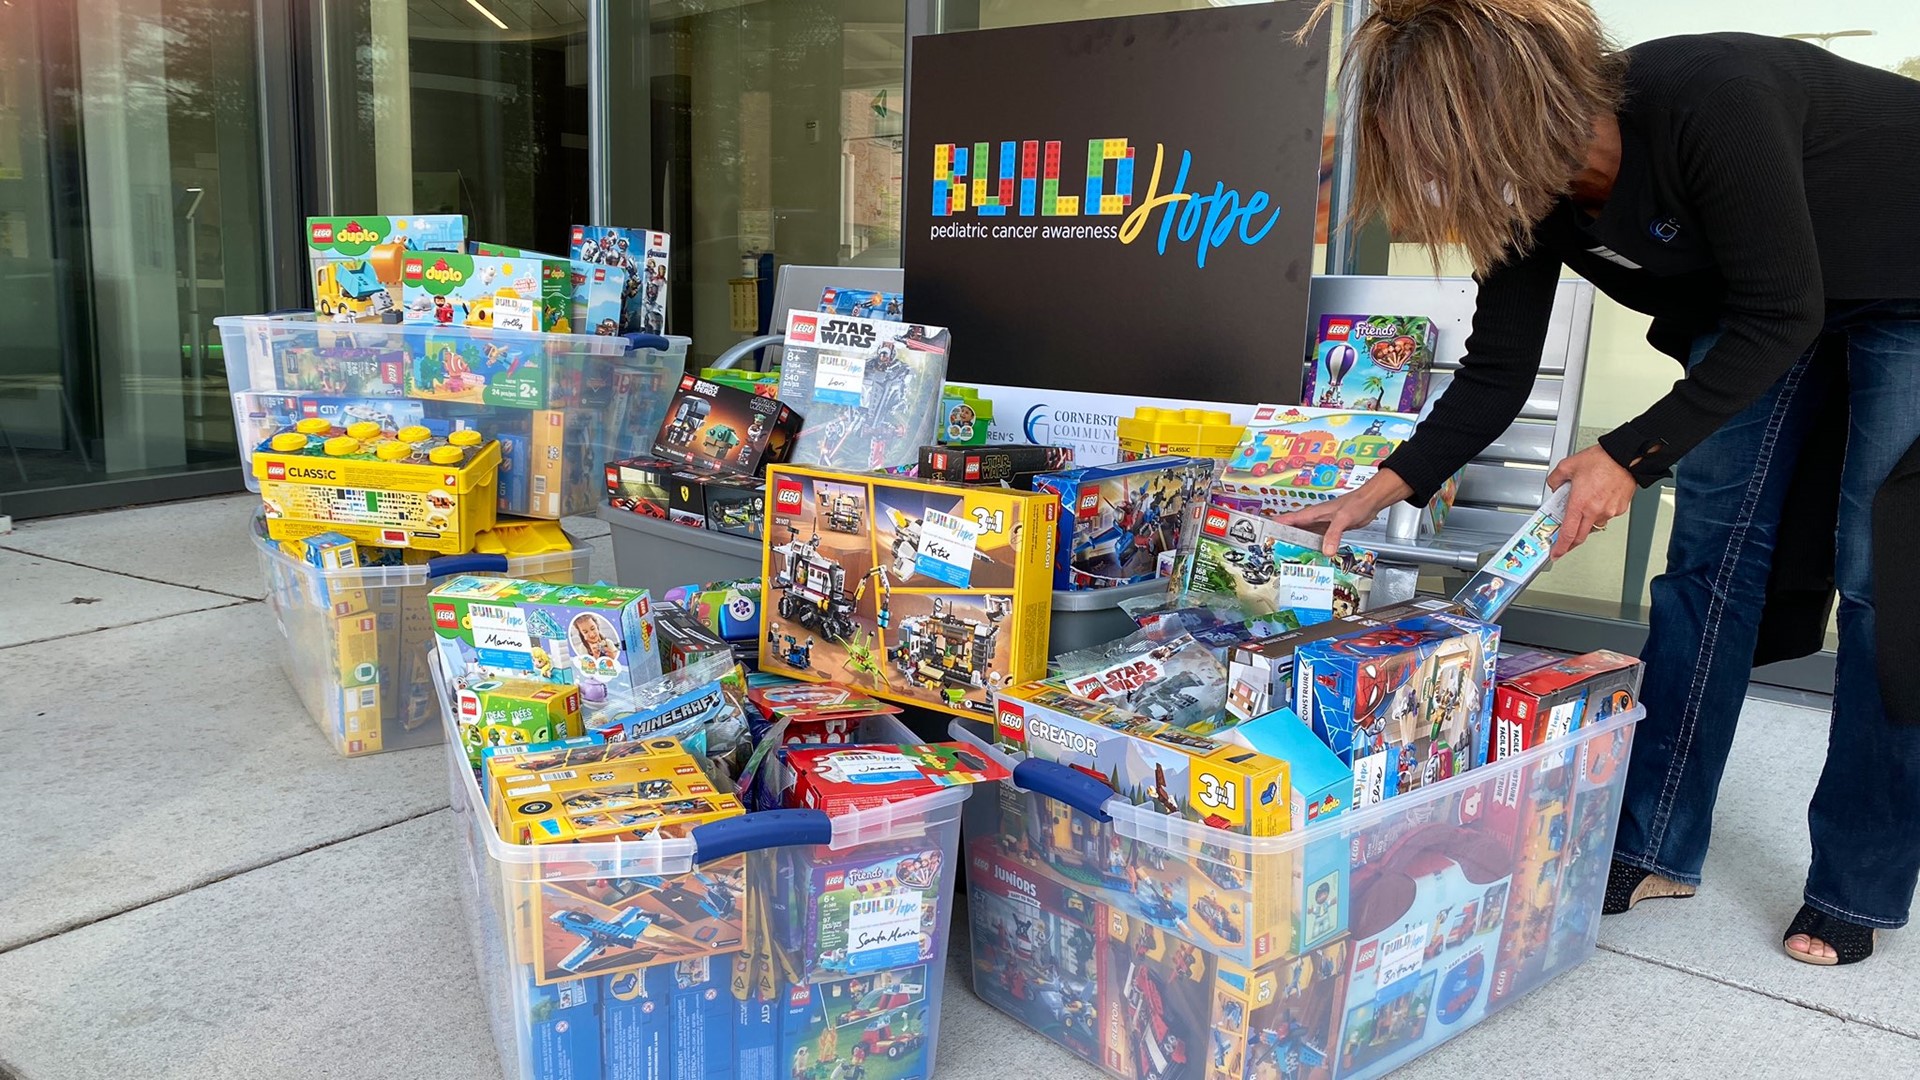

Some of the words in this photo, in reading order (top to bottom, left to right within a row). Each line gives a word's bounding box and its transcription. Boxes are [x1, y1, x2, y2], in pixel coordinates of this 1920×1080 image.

[931, 137, 1135, 216] BUILD
[1118, 143, 1280, 268] Hope
[313, 227, 332, 239] LEGO
[337, 228, 379, 244] duplo
[930, 223, 988, 240] pediatric
[992, 226, 1039, 239] cancer
[1042, 225, 1118, 239] awareness
[405, 264, 422, 274] LEGO
[425, 268, 463, 284] duplo
[502, 318, 523, 330] Holly
[793, 323, 815, 334] LEGO
[821, 319, 877, 337] STAR
[1327, 324, 1349, 335] LEGO
[821, 331, 876, 349] WARS
[786, 351, 800, 361] 8+
[820, 356, 848, 367] BUILD
[784, 374, 799, 382] 540
[520, 383, 539, 398] 2+
[319, 405, 339, 415] CITY
[1311, 442, 1321, 453] 2
[1325, 442, 1335, 453] 3
[1345, 444, 1356, 455] 4
[1362, 444, 1373, 455] 5
[1378, 445, 1389, 457] 6
[982, 454, 1011, 467] STAR
[268, 466, 285, 476] LEGO
[288, 467, 337, 480] CLASSIC
[982, 464, 1011, 480] WARS
[778, 490, 801, 504] LEGO
[1081, 494, 1098, 508] LEGO
[775, 517, 790, 526] 31107
[926, 510, 958, 529] BUILD
[1207, 516, 1227, 528] LEGO
[925, 540, 950, 560] Katie
[1283, 564, 1314, 578] BUILD
[437, 610, 455, 621] LEGO
[471, 605, 505, 620] BUILD
[1103, 660, 1155, 684] STAR
[1106, 666, 1158, 692] WARS
[631, 690, 720, 739] MINECRAFT
[1001, 711, 1022, 730] LEGO
[1028, 718, 1098, 757] CREATOR
[858, 765, 901, 773] James
[826, 876, 843, 886] LEGO
[823, 895, 835, 903] 6+
[853, 898, 894, 916] BUILD
[1496, 970, 1507, 996] LEGO
[791, 991, 809, 1000] LEGO
[1111, 1001, 1119, 1048] CREATOR
